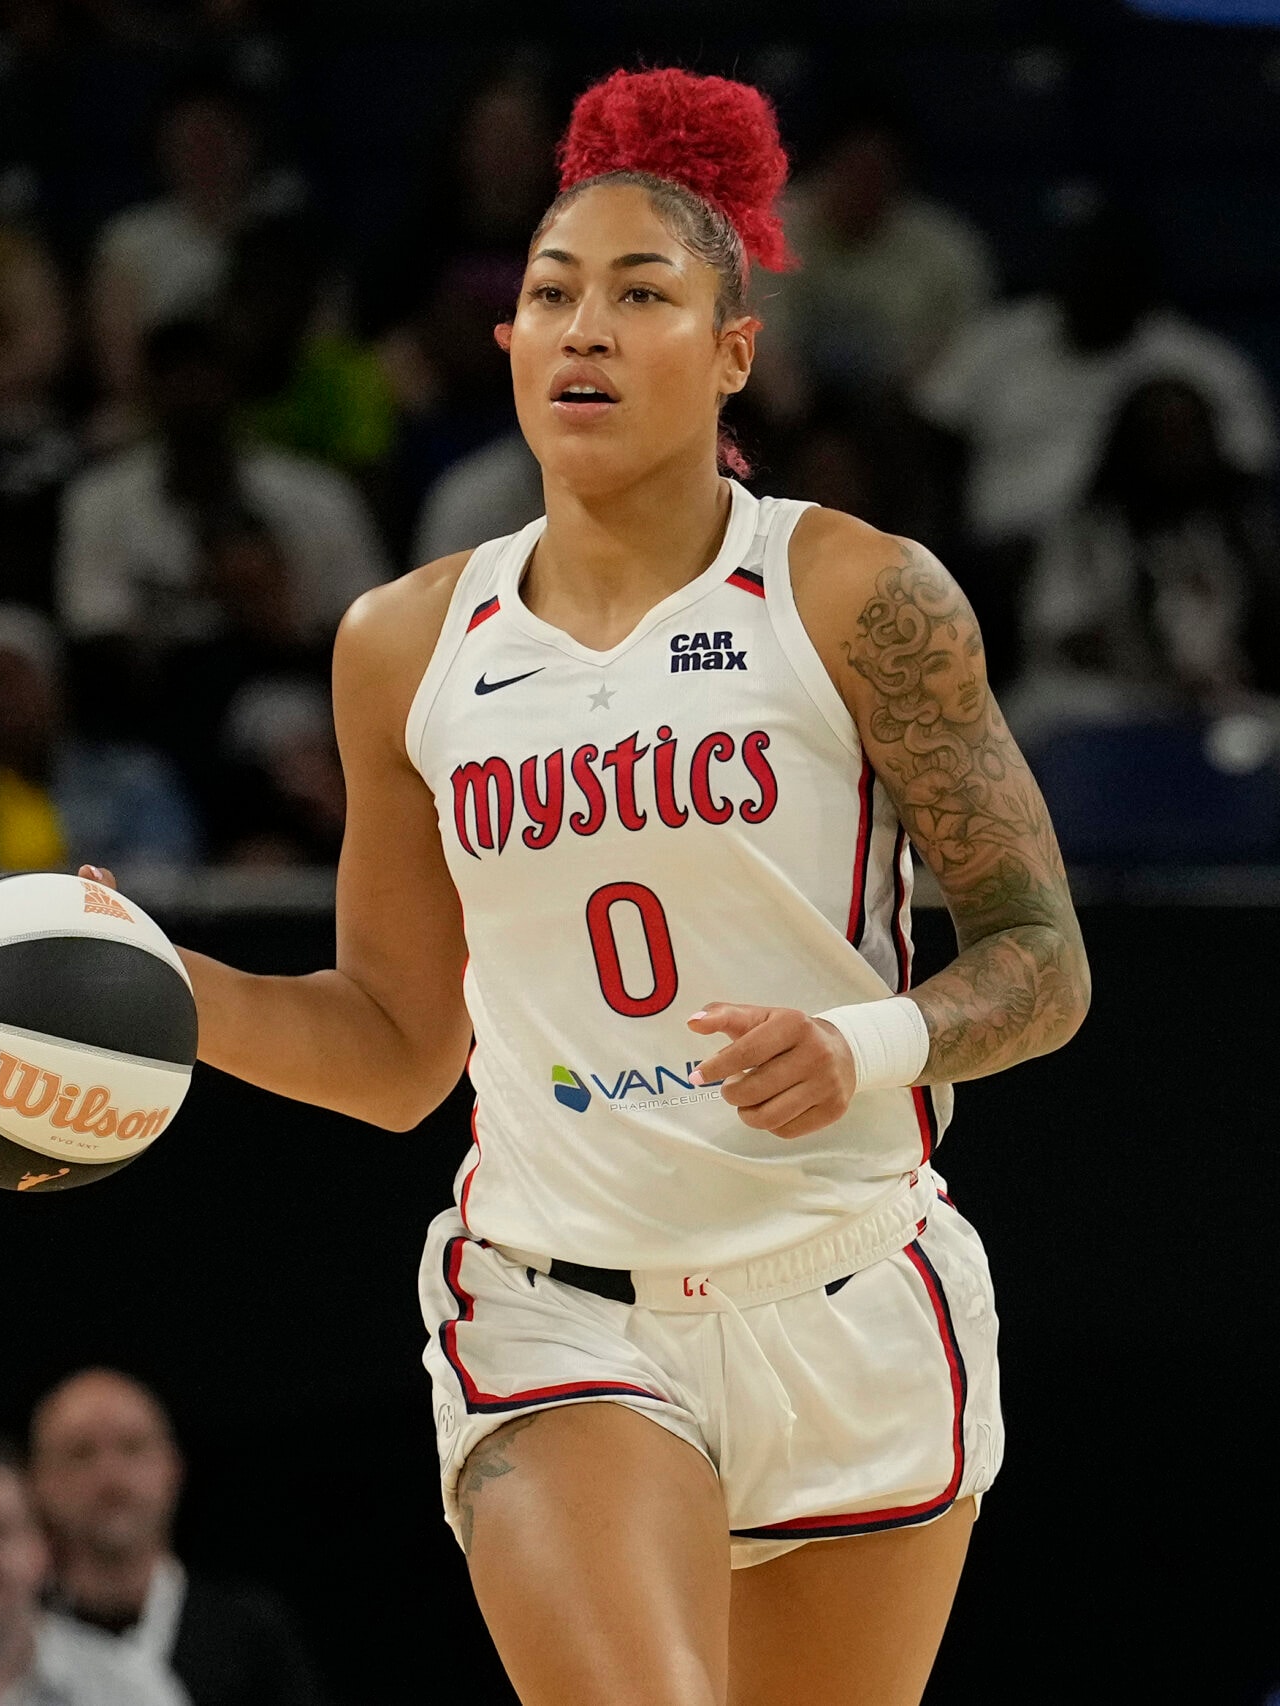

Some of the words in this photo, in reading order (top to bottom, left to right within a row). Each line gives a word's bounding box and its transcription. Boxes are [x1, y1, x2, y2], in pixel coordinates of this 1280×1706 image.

[670, 631, 733, 653] CAR
[671, 651, 748, 673] max
[450, 725, 778, 860] mystics
[586, 881, 678, 1018] 0
[590, 1060, 725, 1100] VAN
[609, 1091, 723, 1112] PHARMACEUTIC
